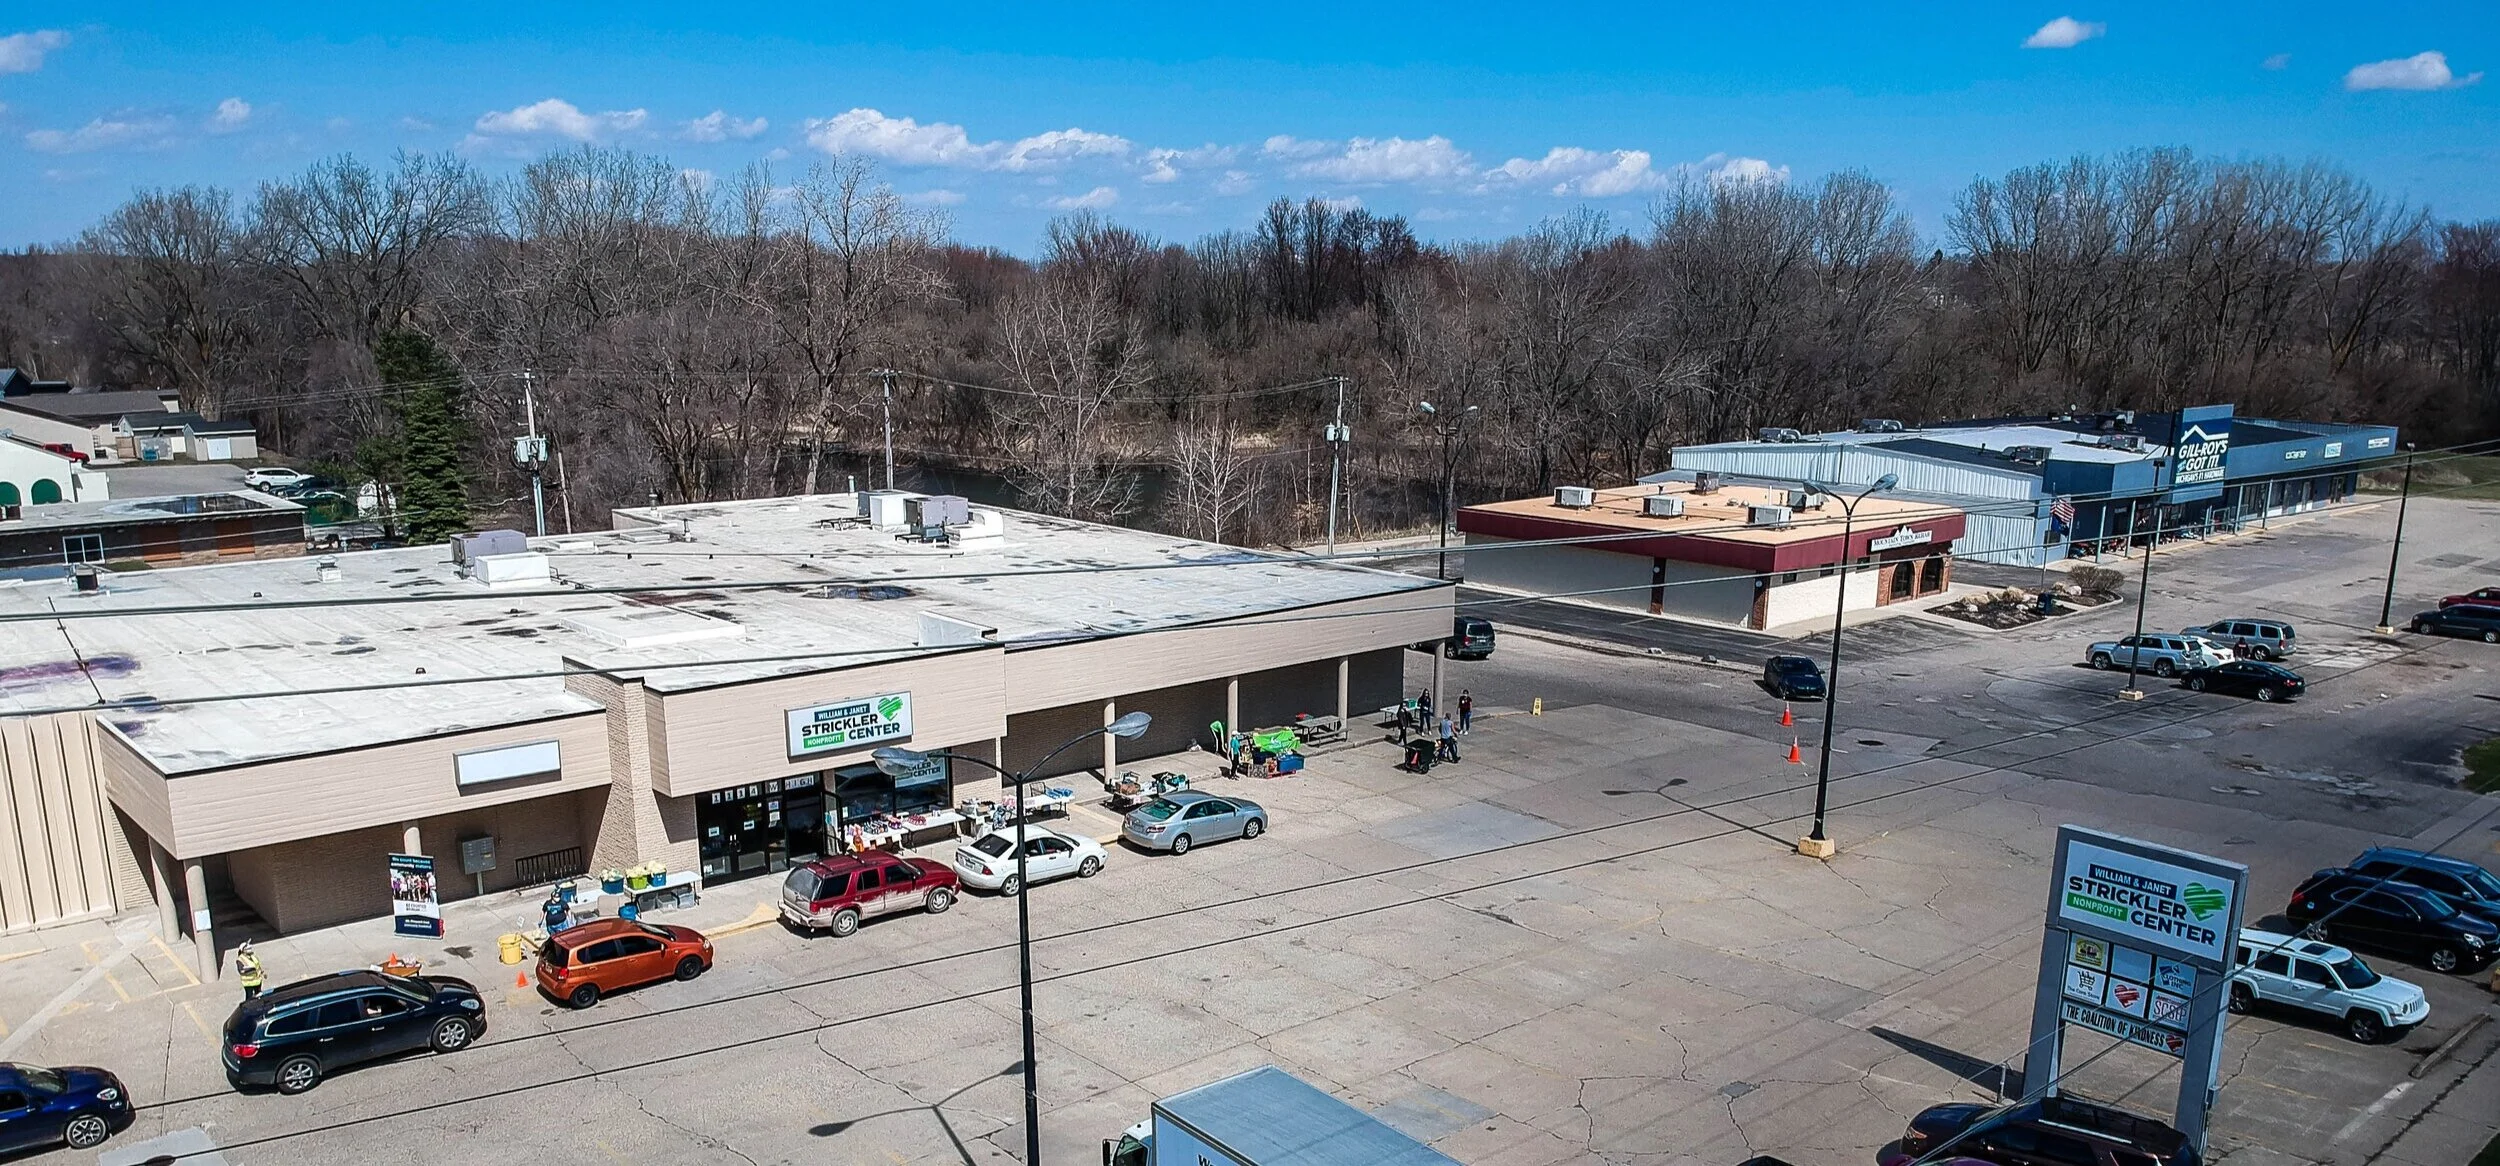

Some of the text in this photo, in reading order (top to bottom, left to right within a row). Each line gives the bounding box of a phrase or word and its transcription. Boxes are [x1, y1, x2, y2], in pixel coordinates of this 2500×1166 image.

[2186, 456, 2208, 471] GOT
[817, 709, 842, 720] WILLIAM
[848, 705, 868, 715] JANET
[802, 714, 878, 736] STRICKLER
[848, 722, 901, 740] CENTER
[807, 734, 841, 747] NONPROFIT
[769, 782, 778, 793] W
[2094, 867, 2172, 896] WILLIAM & JANET
[2069, 876, 2187, 920] STRICKLER
[2073, 896, 2123, 917] NONPROFIT
[2131, 911, 2217, 946] CENTER
[2066, 1004, 2079, 1019] THE
[2081, 1009, 2115, 1032] COALITION
[2117, 1021, 2127, 1035] OF
